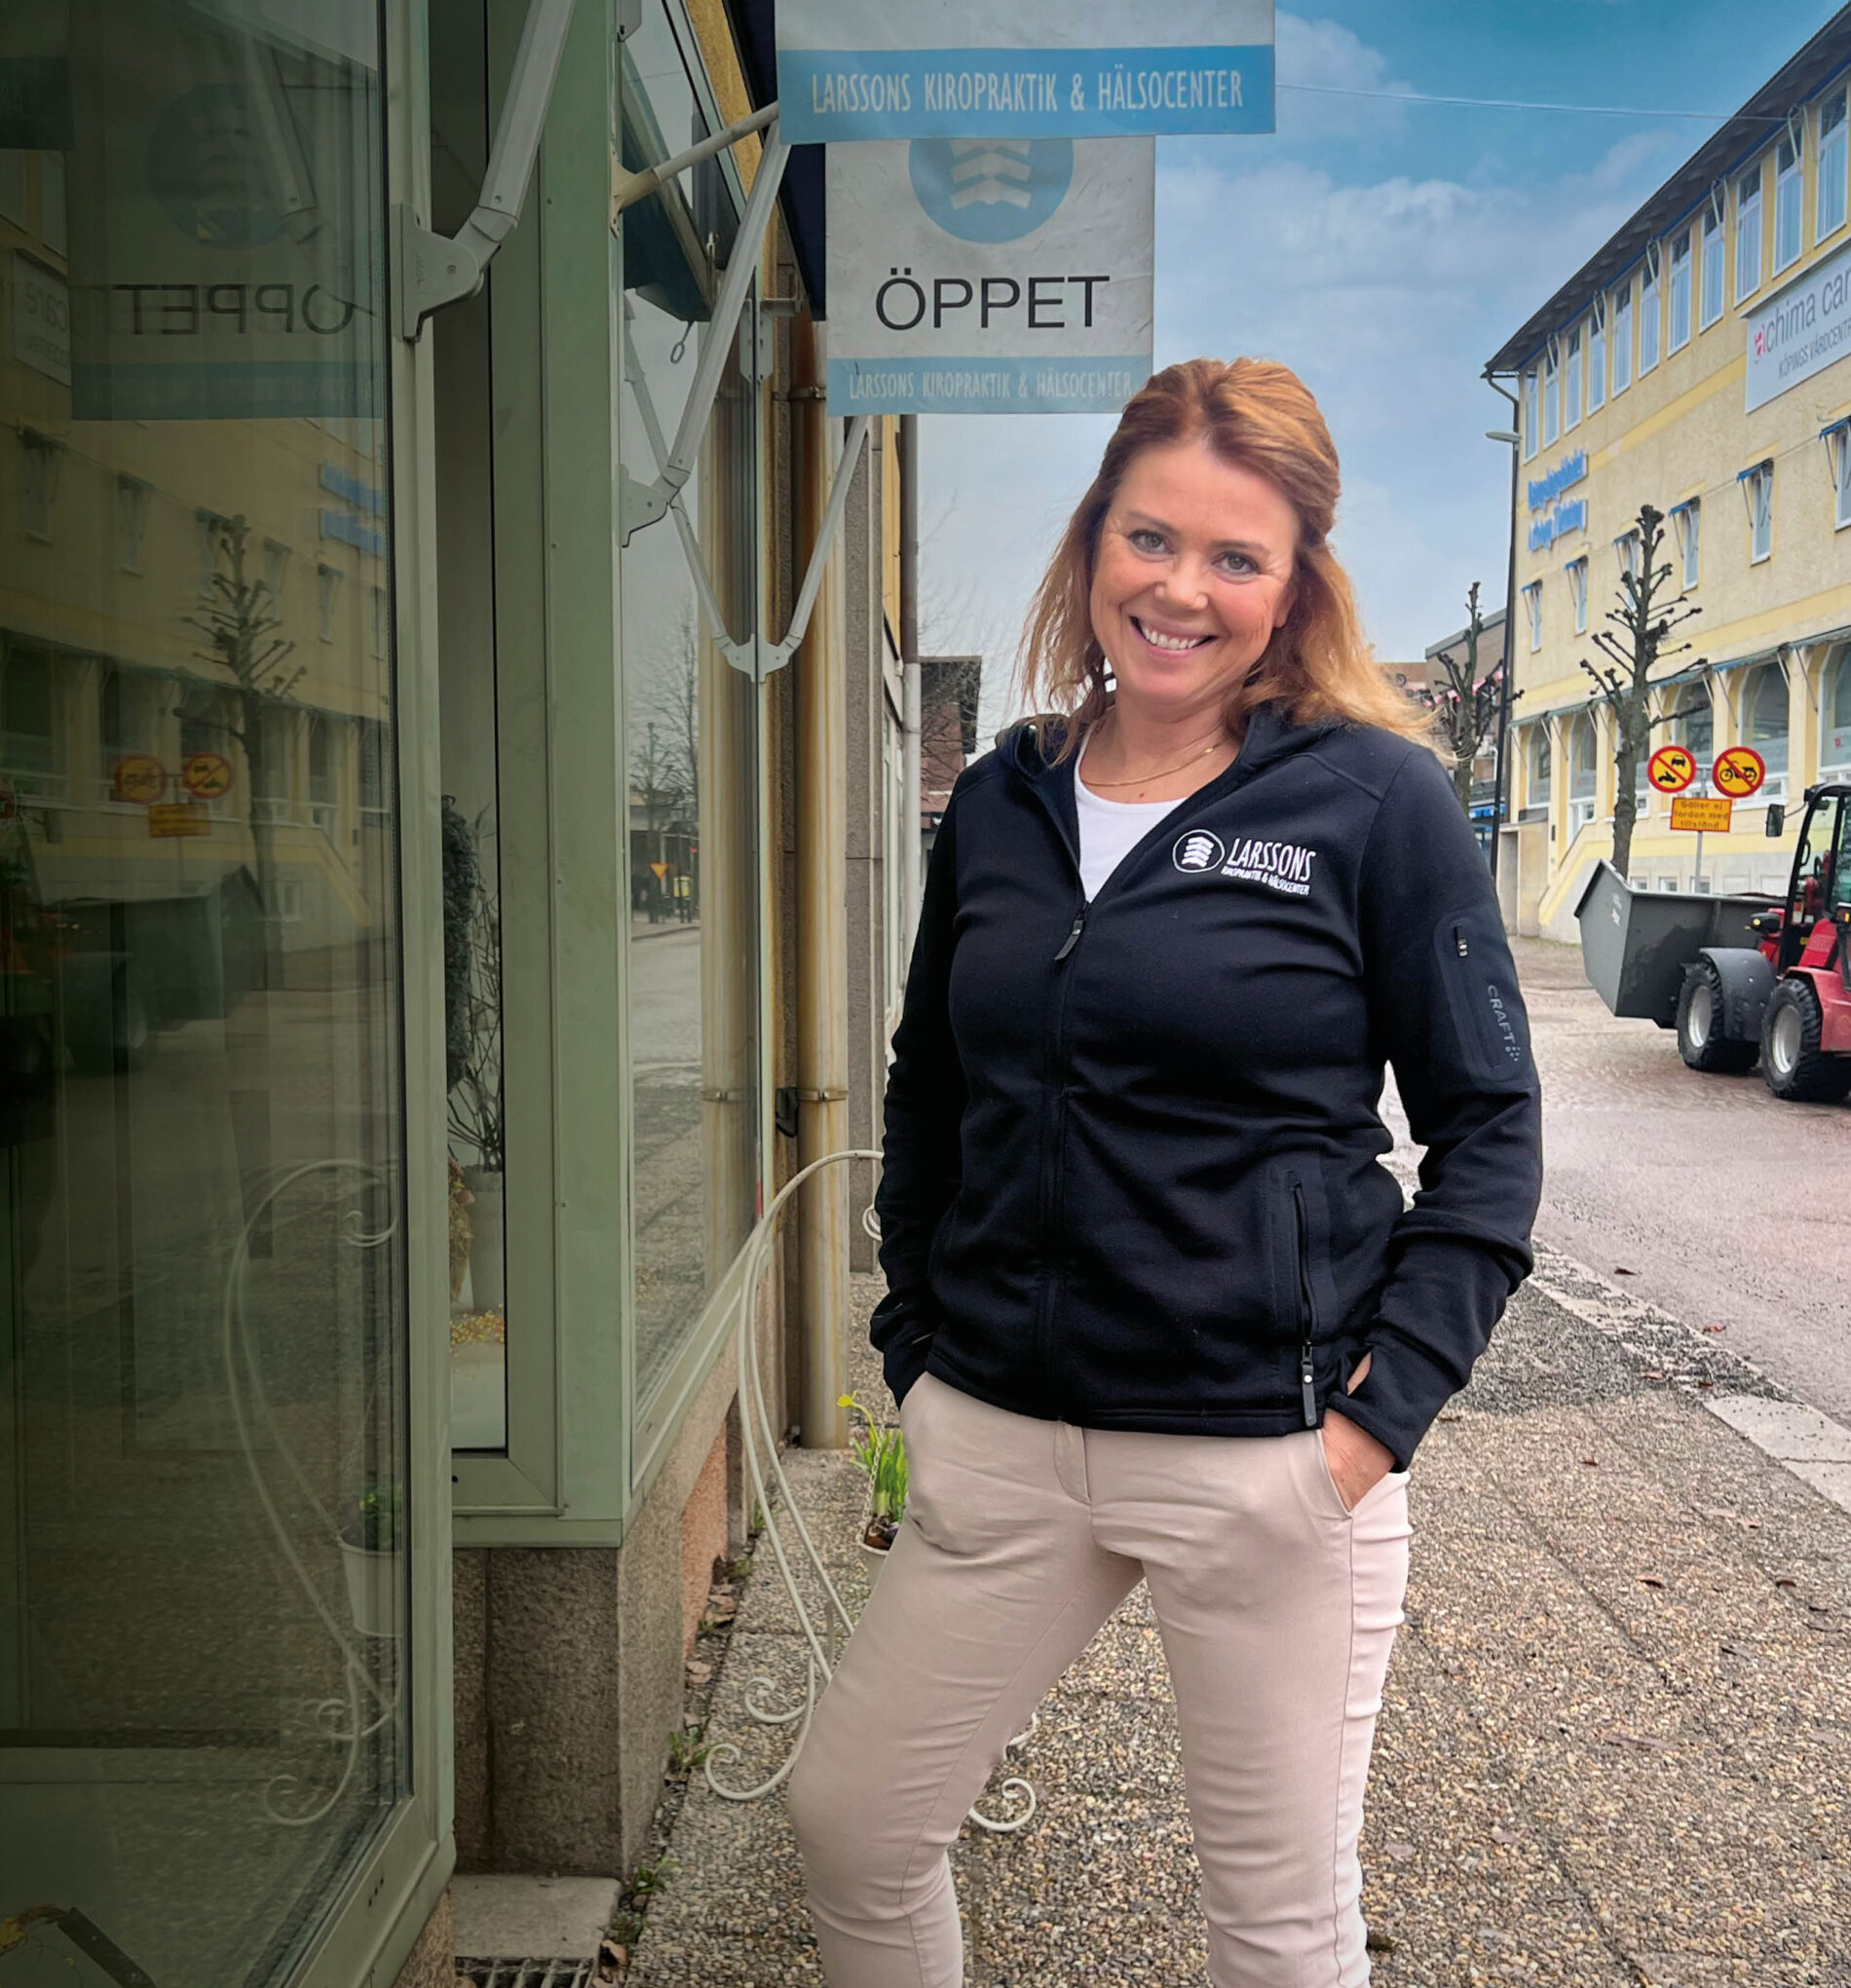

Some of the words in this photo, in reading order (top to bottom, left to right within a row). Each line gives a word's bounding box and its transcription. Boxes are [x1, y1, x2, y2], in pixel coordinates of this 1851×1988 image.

[812, 72, 912, 114] LARSSONS
[1071, 72, 1085, 110] &
[1098, 64, 1243, 110] HÄLSOCENTER
[876, 267, 1111, 330] ÖPPET
[849, 372, 915, 400] LARSSONS
[923, 371, 1010, 398] KIROPRAKTIK
[1018, 372, 1028, 398] &
[1037, 367, 1132, 398] HÄLSOCENTER
[1227, 838, 1317, 882] LARSSONS
[1488, 985, 1516, 1044] CRAFT
